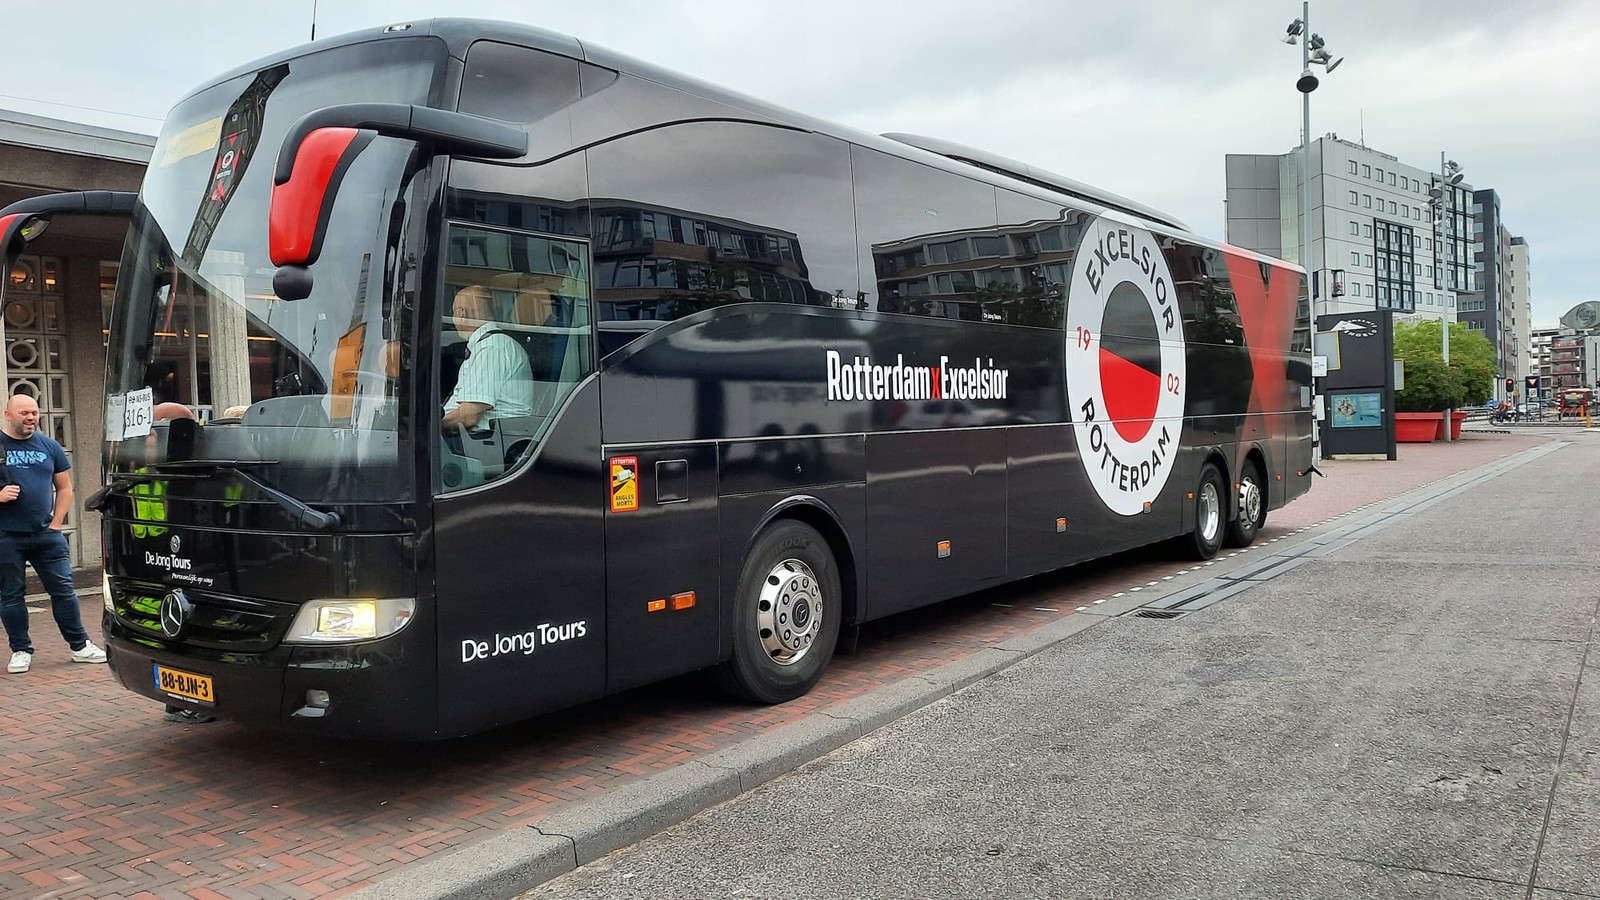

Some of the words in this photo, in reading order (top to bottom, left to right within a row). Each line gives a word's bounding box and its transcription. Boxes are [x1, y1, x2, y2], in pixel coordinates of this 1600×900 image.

[1086, 229, 1175, 333] EXCELSIOR
[1076, 326, 1091, 351] 19
[1167, 373, 1180, 395] 02
[126, 406, 152, 427] 316-1
[1081, 397, 1171, 492] ROTTERDAM
[145, 551, 155, 565] De
[155, 552, 171, 571] Jong
[170, 554, 191, 570] Tours
[461, 639, 488, 663] De
[491, 631, 535, 655] Jong
[537, 620, 587, 645] Tours
[161, 670, 209, 698] 88-BJN-3
